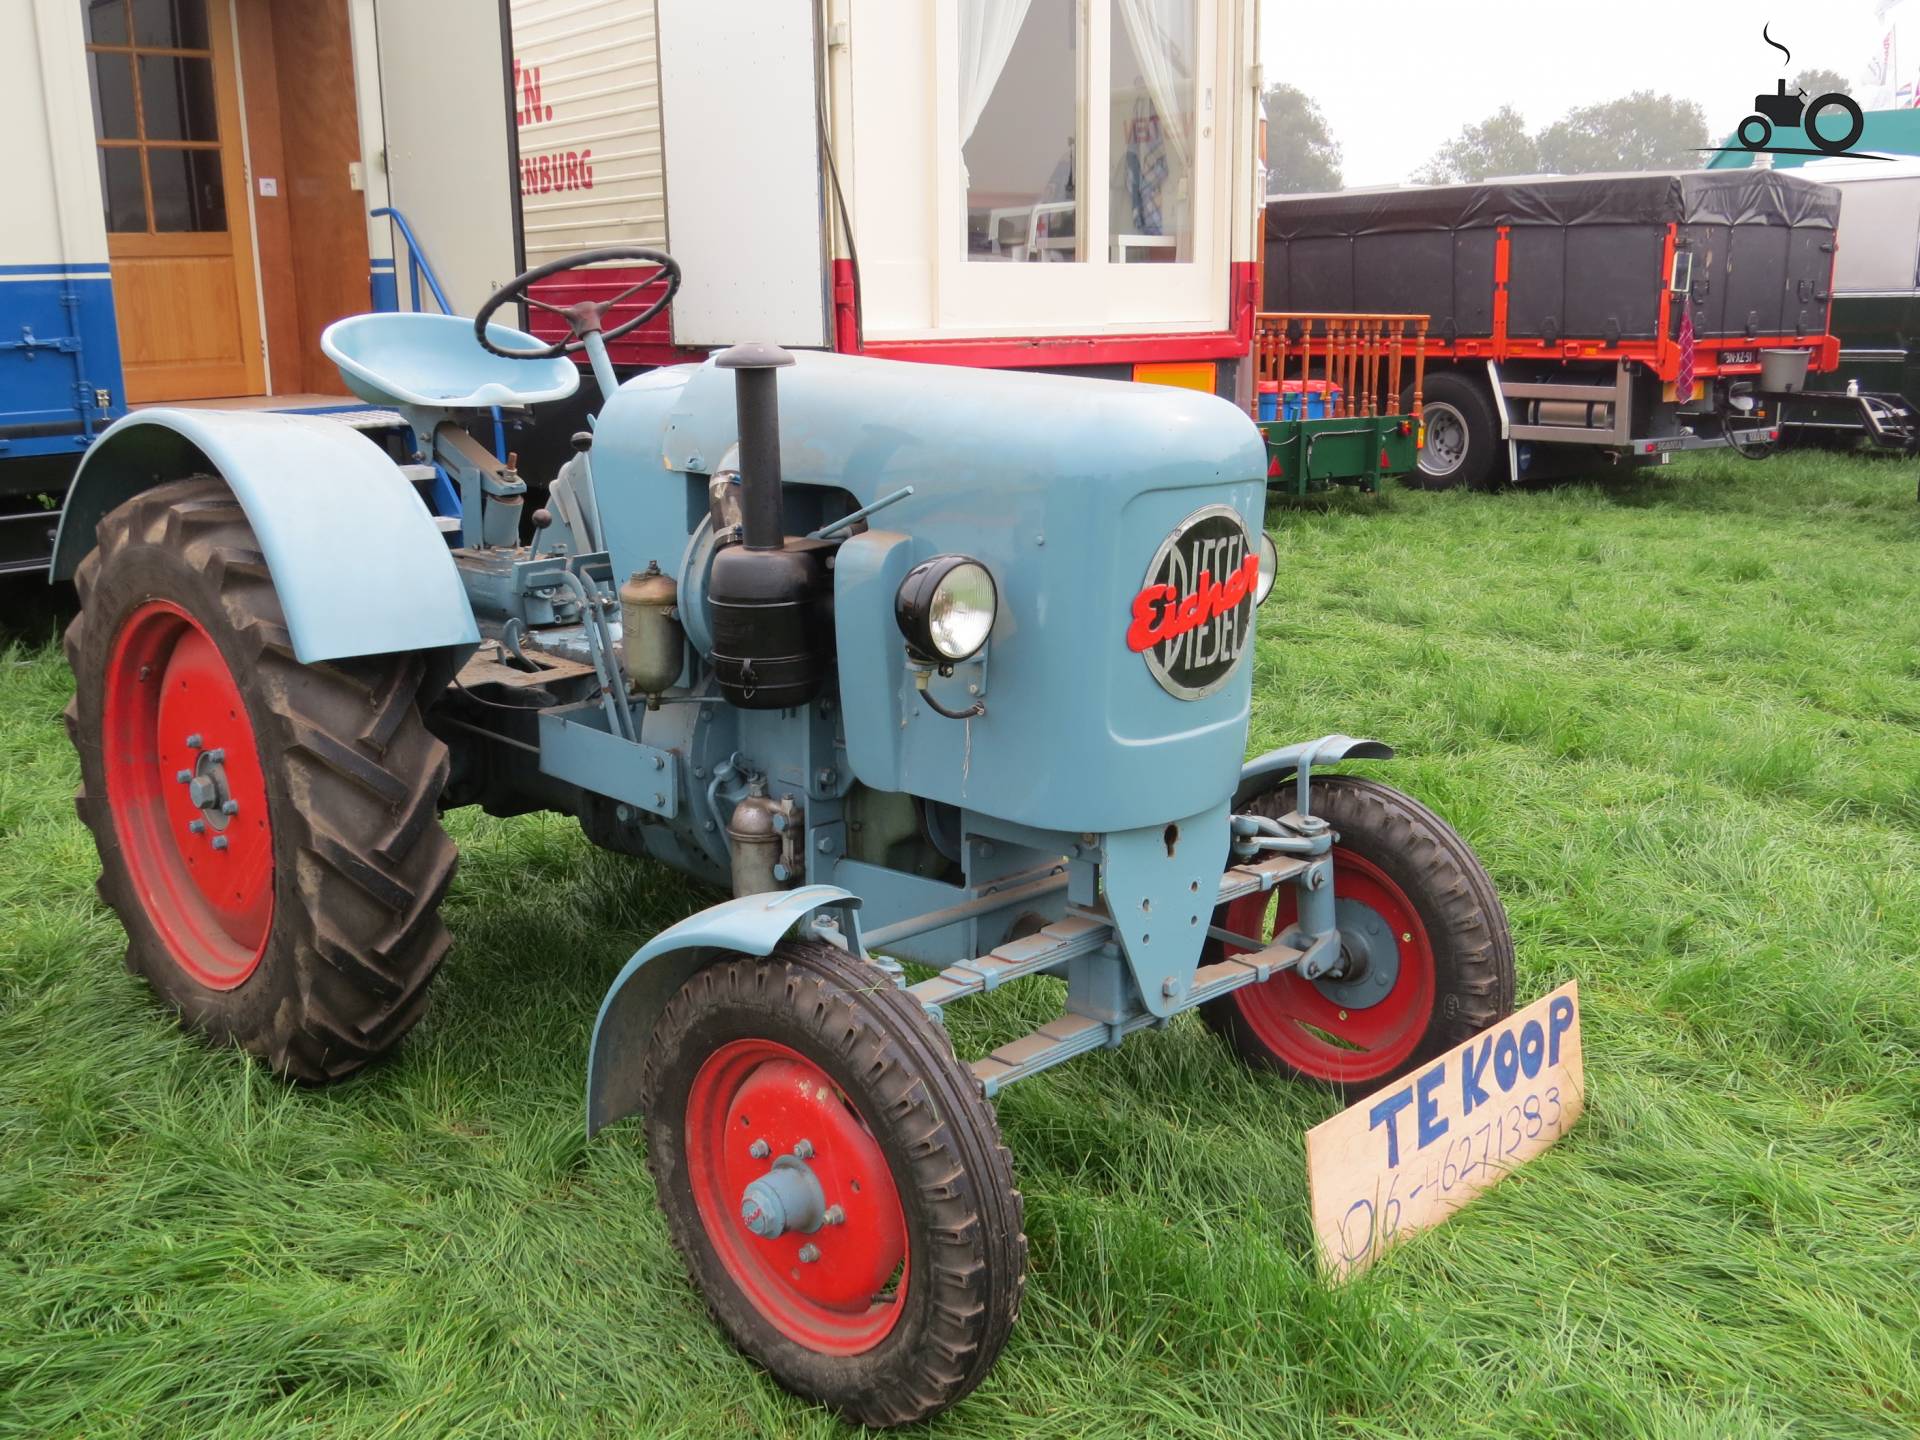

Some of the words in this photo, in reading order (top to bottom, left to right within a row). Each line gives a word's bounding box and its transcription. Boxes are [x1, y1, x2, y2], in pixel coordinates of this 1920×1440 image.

[1127, 552, 1260, 653] Eicher
[1368, 1062, 1449, 1169] TE
[1461, 995, 1574, 1117] KOOP
